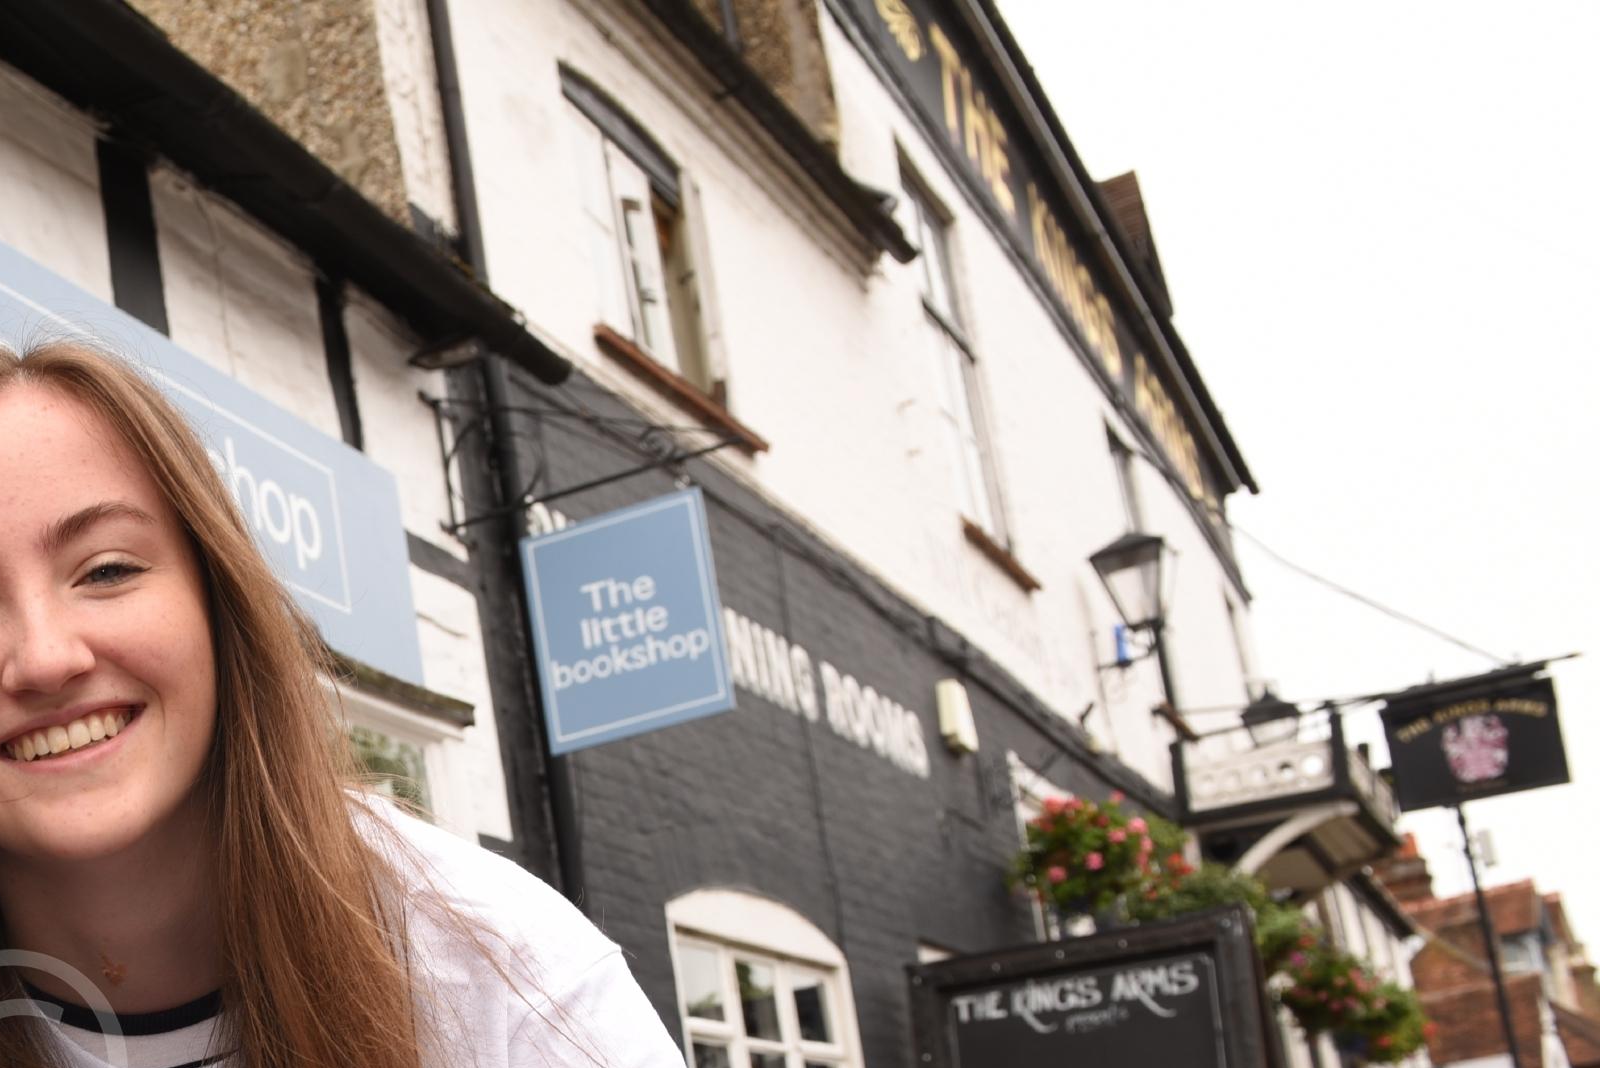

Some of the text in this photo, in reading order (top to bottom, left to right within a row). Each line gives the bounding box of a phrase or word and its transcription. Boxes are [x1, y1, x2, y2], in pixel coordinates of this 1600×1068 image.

[580, 575, 656, 612] The
[581, 605, 668, 649] little
[551, 628, 709, 690] bookshop
[953, 960, 1199, 1034] THE KINGS ARMS
